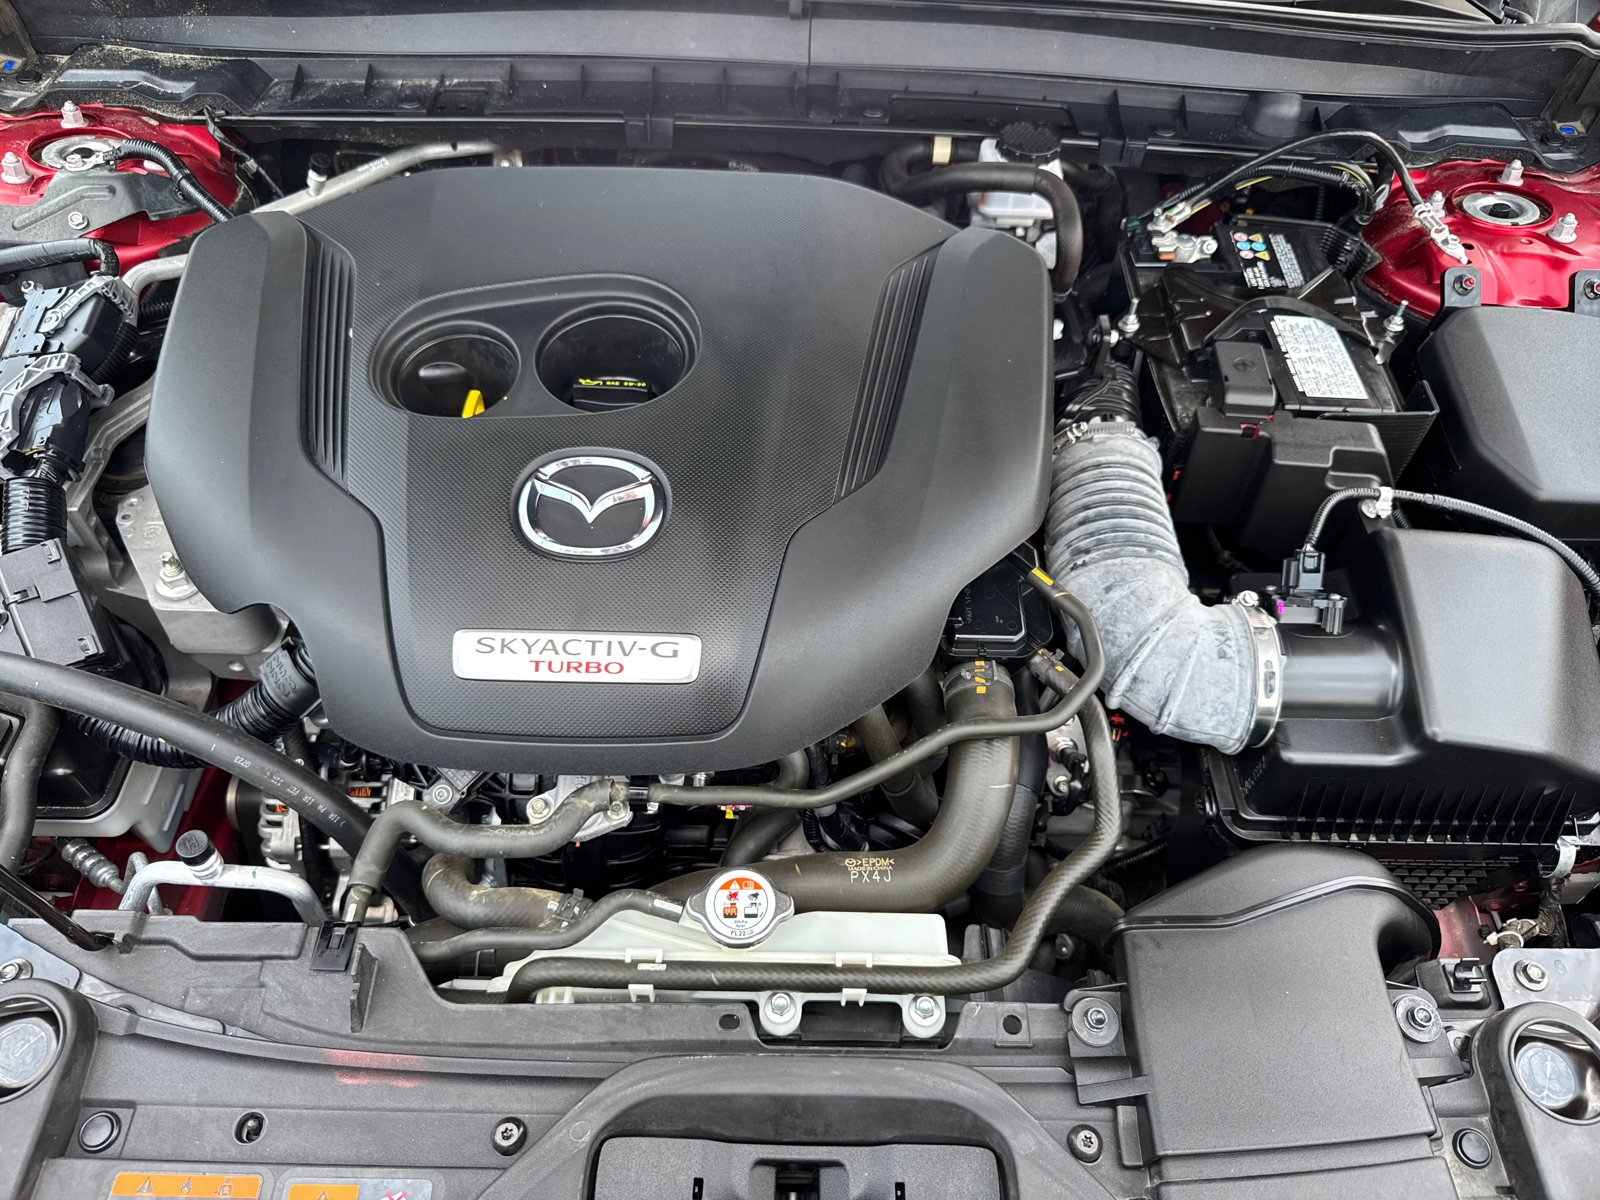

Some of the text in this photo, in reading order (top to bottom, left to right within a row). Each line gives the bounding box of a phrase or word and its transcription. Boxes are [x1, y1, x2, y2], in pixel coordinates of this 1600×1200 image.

[475, 636, 679, 658] SKYACTIV-G
[530, 660, 624, 674] TURBO
[234, 755, 252, 768] 0723
[850, 870, 891, 883] PX4J
